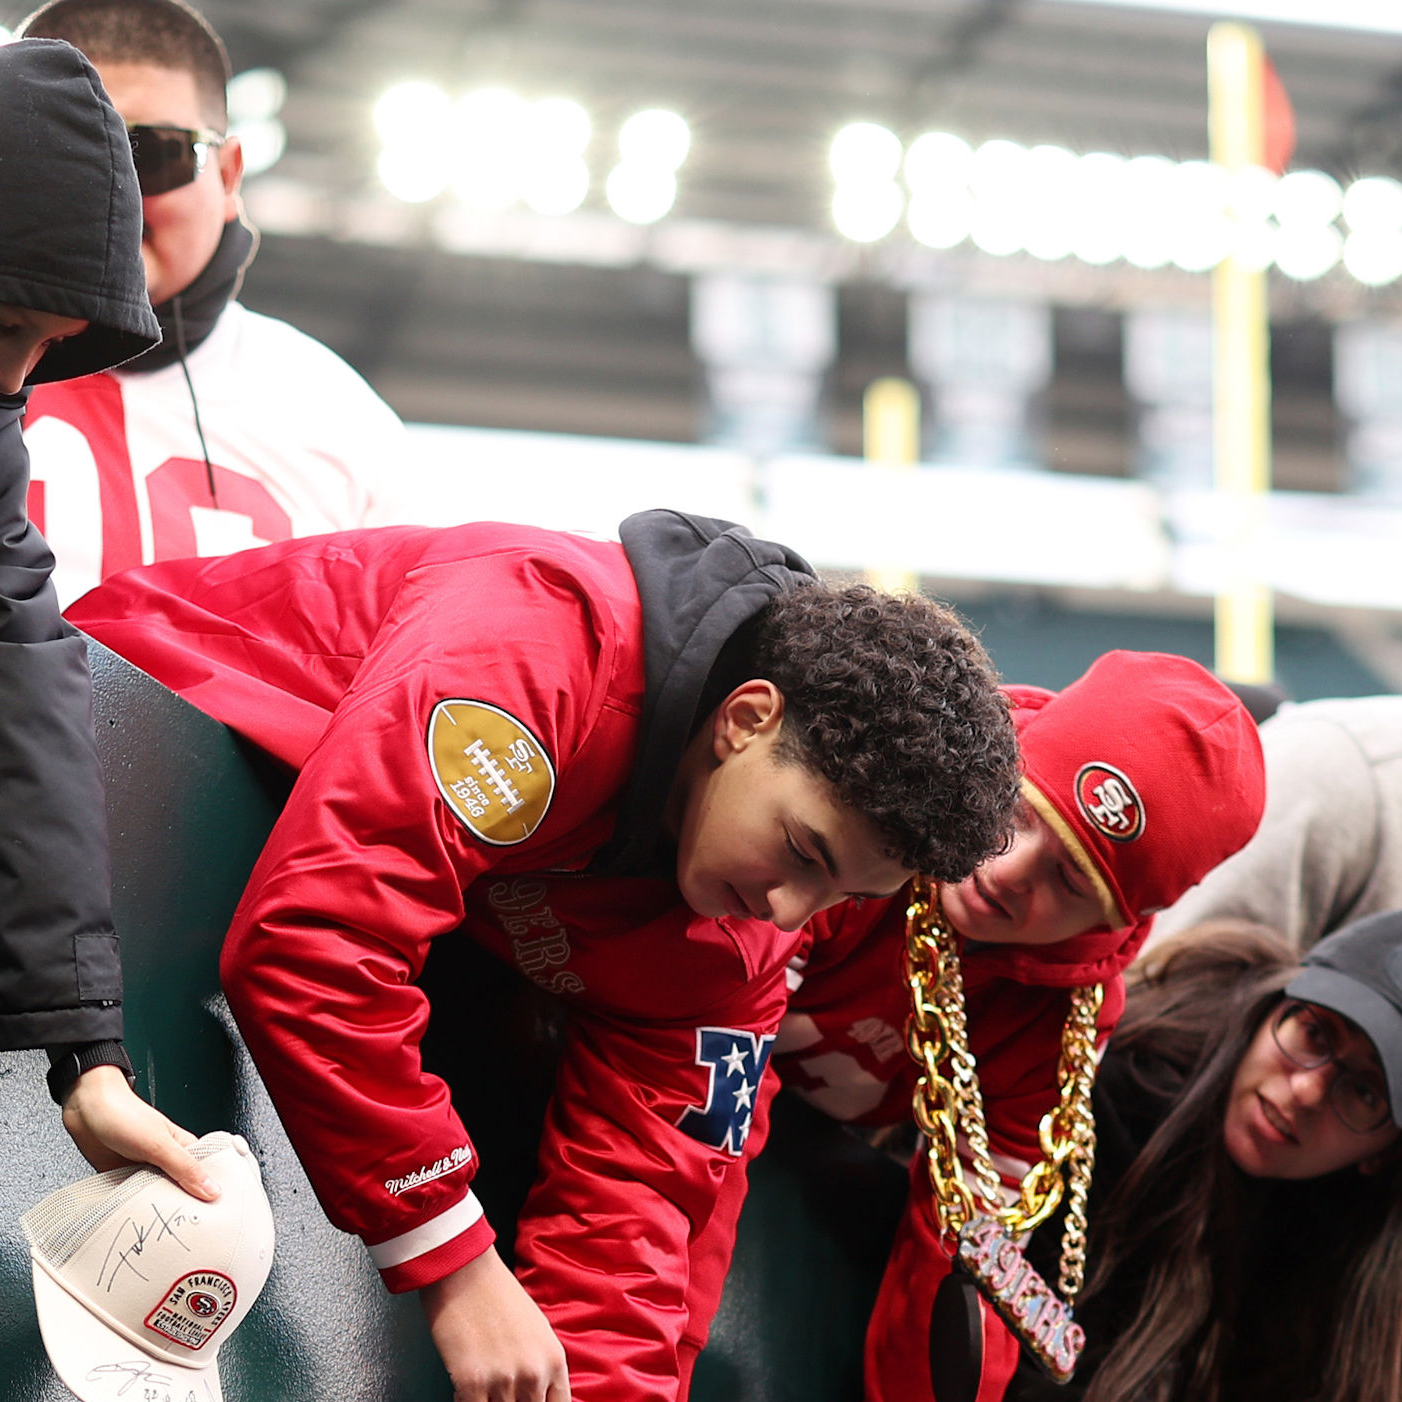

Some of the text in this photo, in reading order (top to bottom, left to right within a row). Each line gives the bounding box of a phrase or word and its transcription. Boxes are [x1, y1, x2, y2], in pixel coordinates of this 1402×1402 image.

[504, 738, 535, 775] SF
[449, 779, 486, 818] 1946
[464, 775, 490, 807] since
[384, 1159, 442, 1195] Mitchell
[169, 1286, 186, 1306] SAN
[974, 1222, 1087, 1374] 49ERS
[156, 1311, 187, 1333] FOOTBALL
